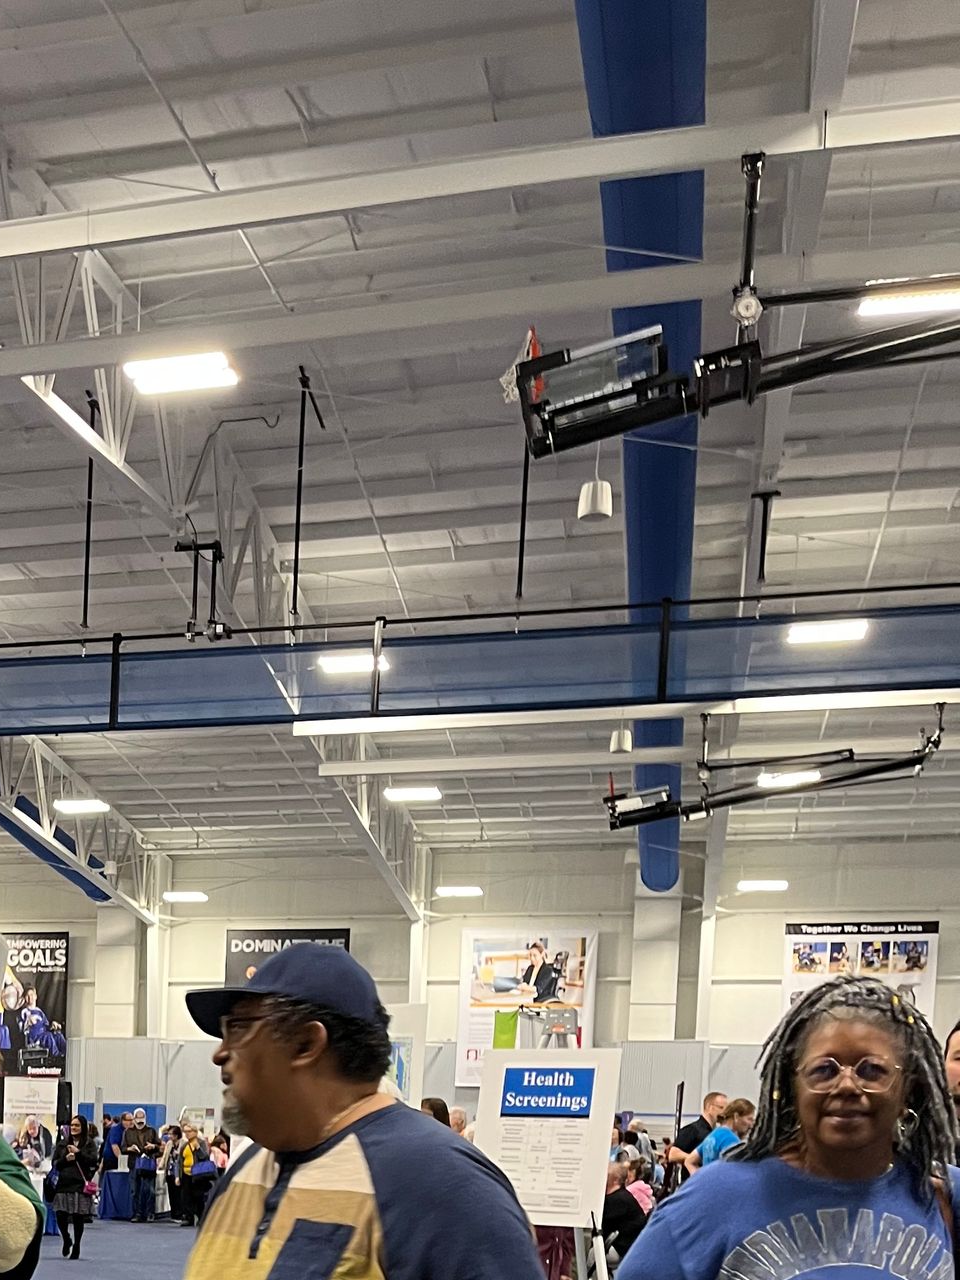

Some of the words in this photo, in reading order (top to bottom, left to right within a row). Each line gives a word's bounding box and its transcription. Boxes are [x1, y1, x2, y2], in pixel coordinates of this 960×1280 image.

[800, 924, 842, 935] Together
[860, 923, 896, 934] Change
[6, 949, 67, 967] GOALS
[522, 1071, 575, 1087] Health
[504, 1091, 589, 1112] Screenings
